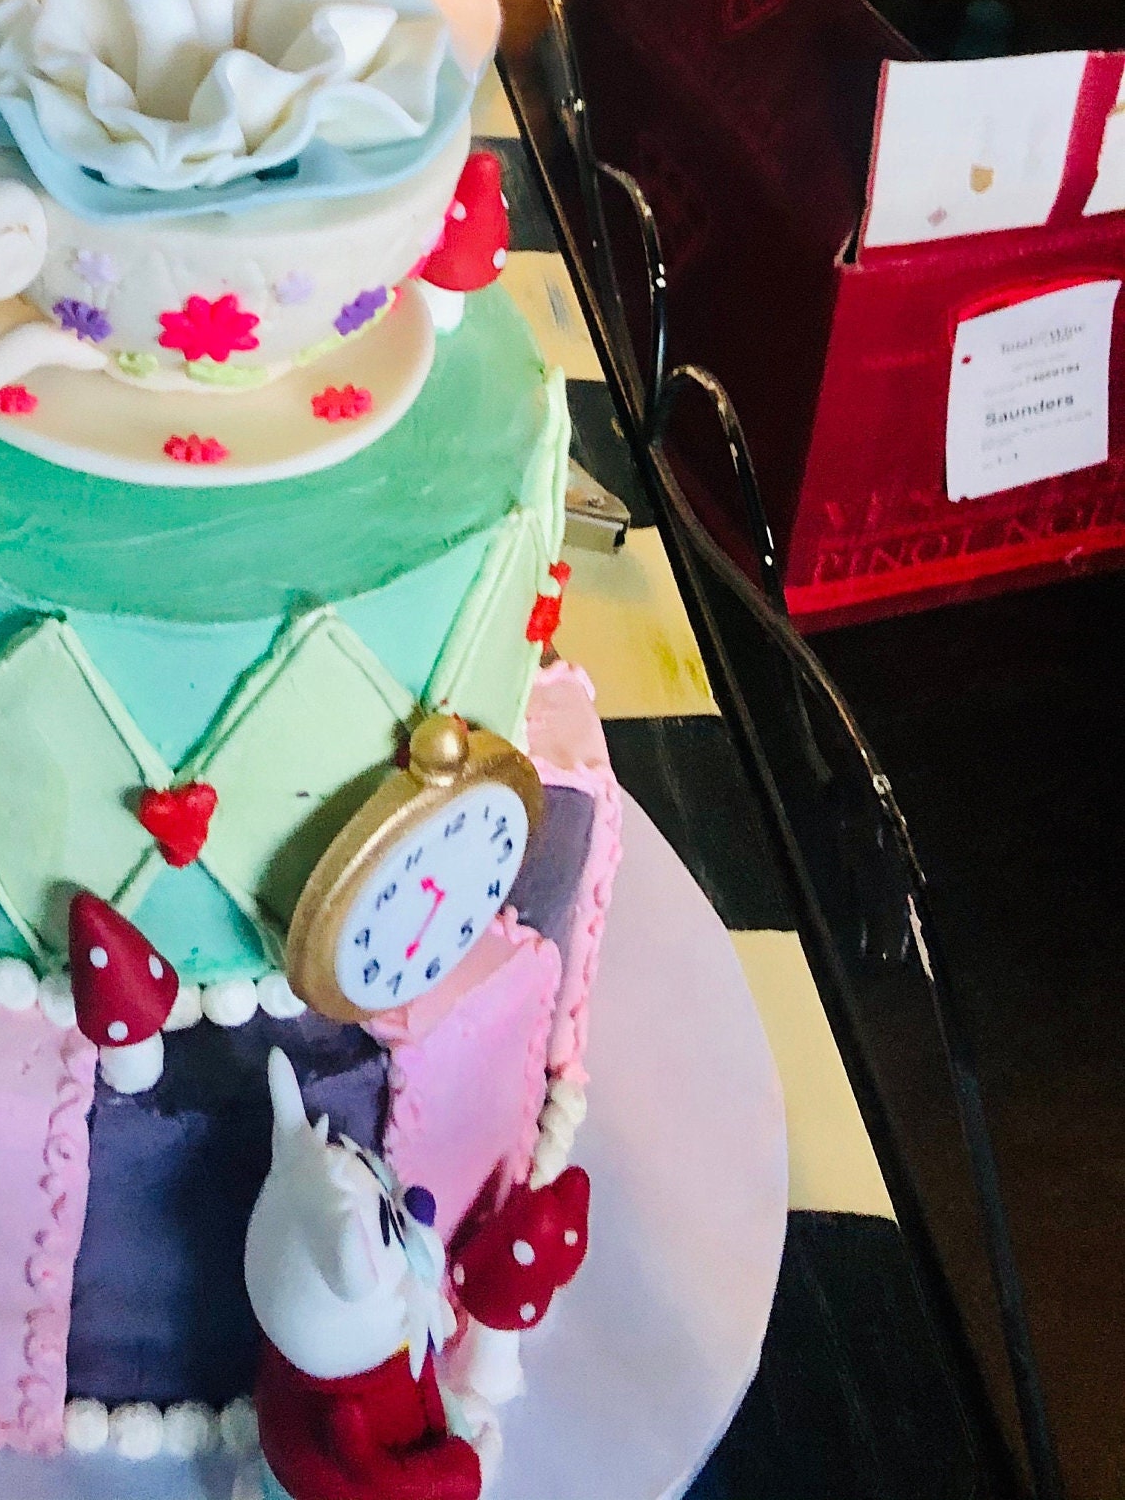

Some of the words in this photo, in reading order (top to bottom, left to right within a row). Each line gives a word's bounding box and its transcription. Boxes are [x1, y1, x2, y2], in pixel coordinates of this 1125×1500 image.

[985, 395, 1074, 427] Saunders
[353, 926, 371, 950] 9
[363, 957, 381, 985] 8
[424, 956, 440, 980] 6
[386, 970, 403, 997] 7
